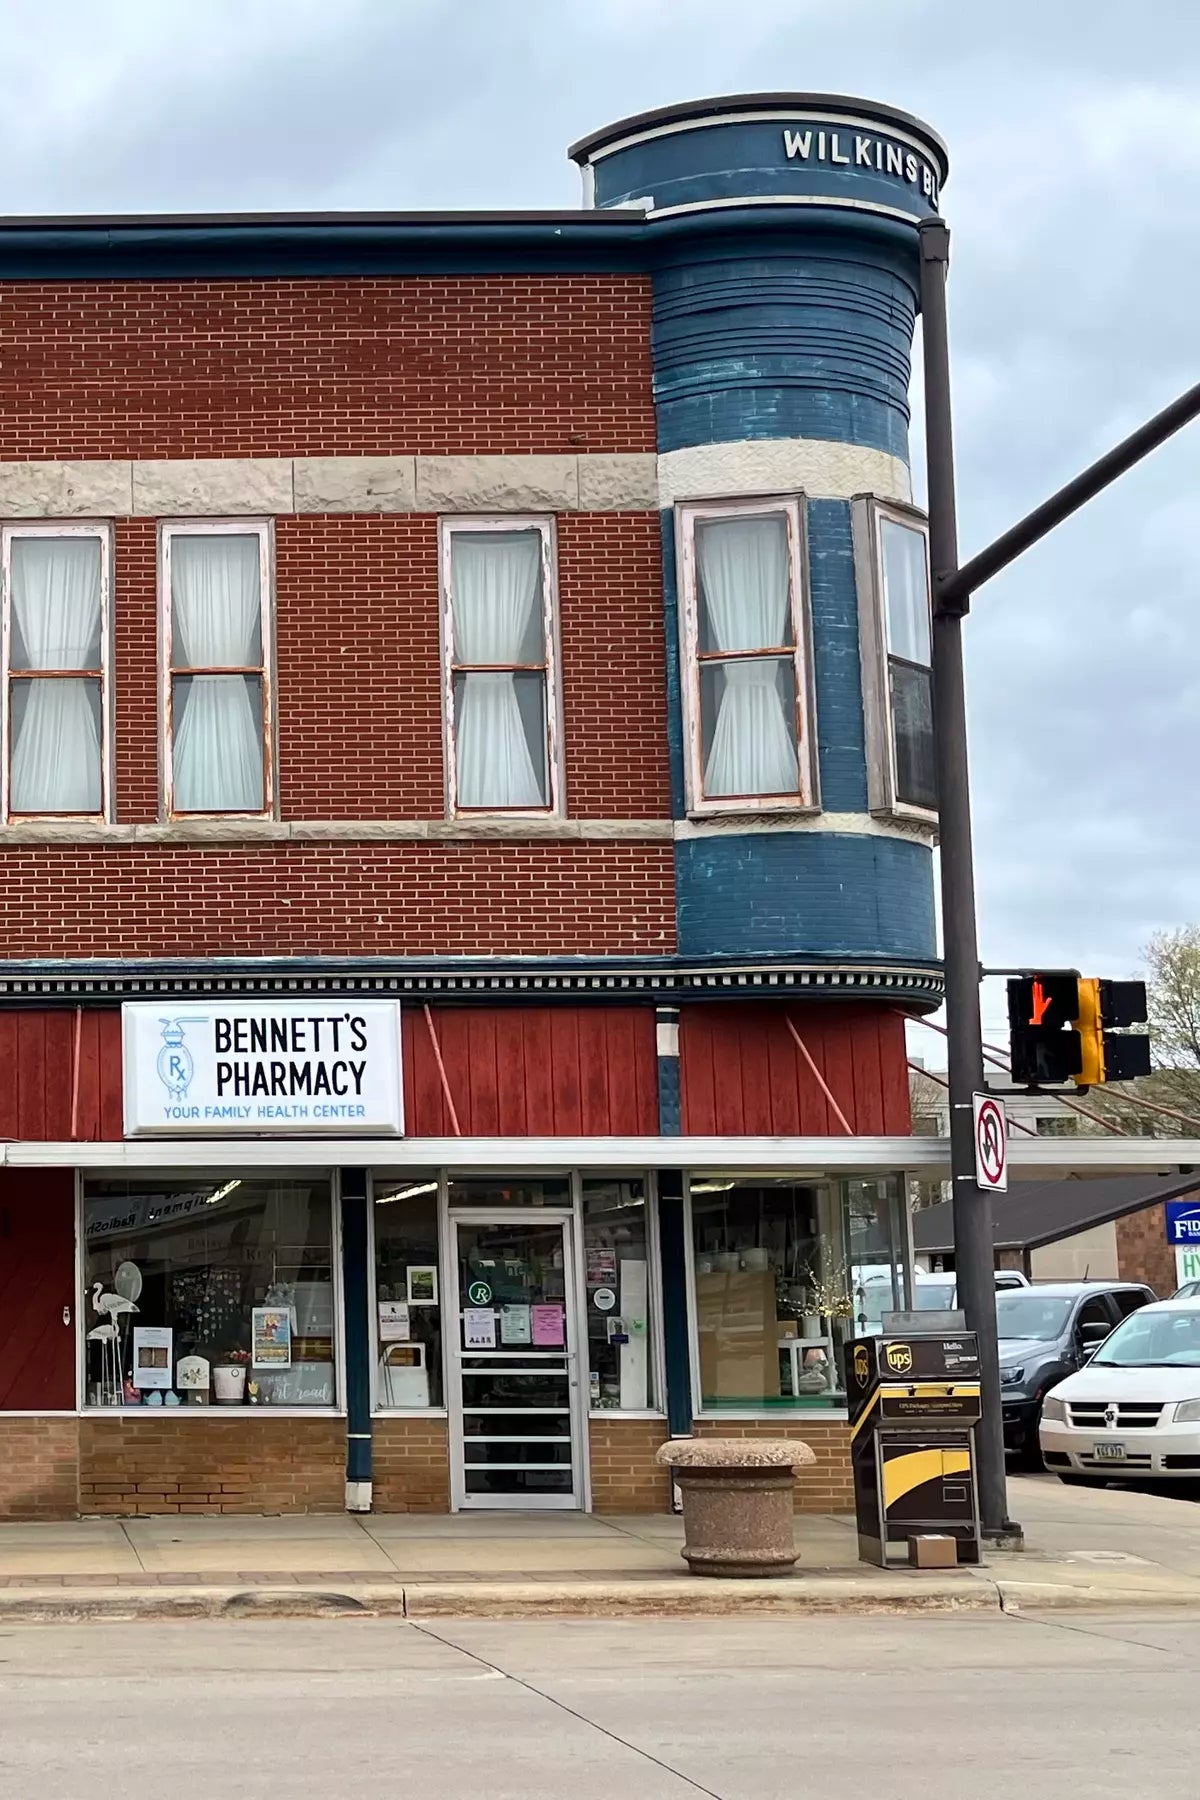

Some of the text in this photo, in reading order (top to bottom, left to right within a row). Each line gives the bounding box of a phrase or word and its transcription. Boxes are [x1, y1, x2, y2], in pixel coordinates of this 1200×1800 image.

[784, 130, 918, 183] WILKINS
[215, 1013, 367, 1053] BENNETT'S
[217, 1061, 366, 1096] PHARMACY
[164, 1105, 365, 1119] YOUR FAMILY HEALTH CENTER
[889, 1353, 911, 1369] ups
